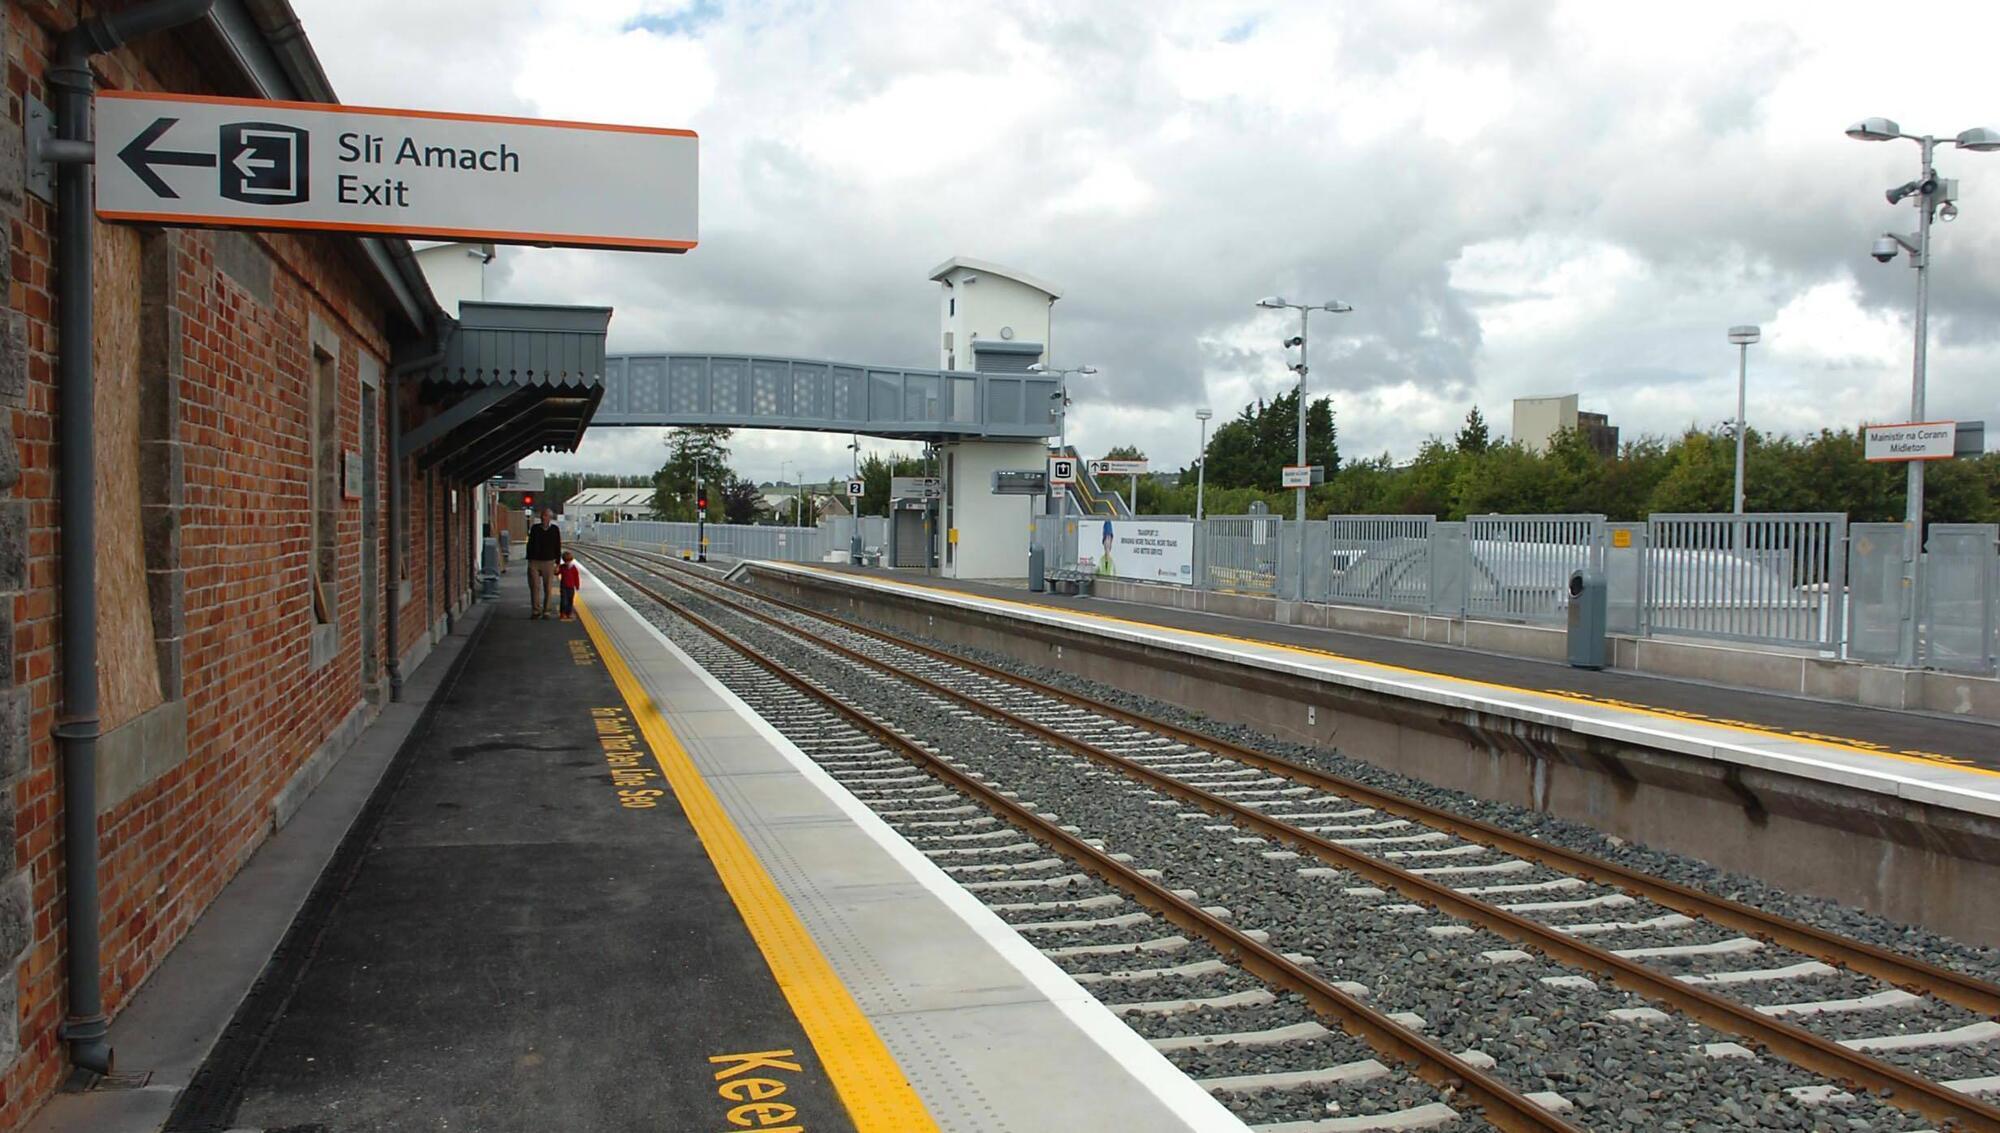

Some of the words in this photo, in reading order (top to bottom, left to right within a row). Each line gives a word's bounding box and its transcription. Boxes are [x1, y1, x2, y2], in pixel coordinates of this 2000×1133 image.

[338, 132, 384, 164] Slí
[395, 137, 519, 172] Amach
[338, 174, 409, 207] Exit
[1870, 432, 1904, 441] Mainistir
[1906, 432, 1916, 440] na
[1918, 430, 1948, 440] Corann
[1889, 443, 1926, 453] Midleton
[605, 752, 645, 767] Den
[612, 768, 659, 786] Líne
[618, 790, 664, 808] Seo
[708, 1049, 804, 1133] Kee
